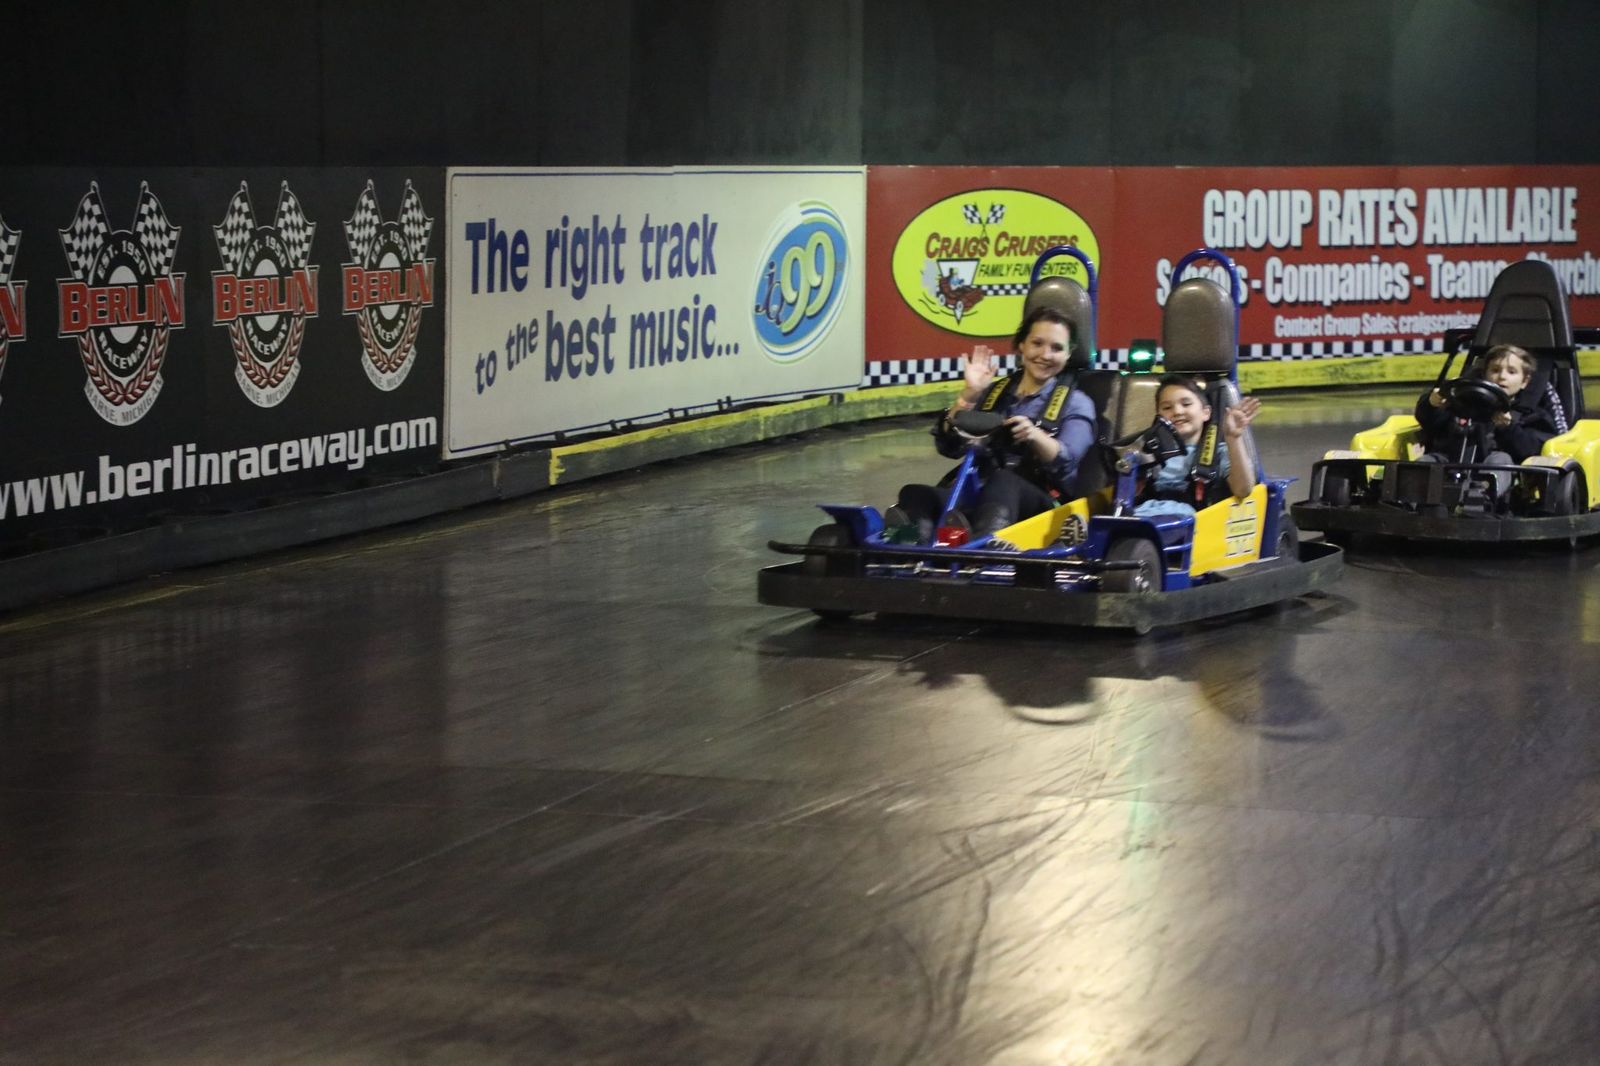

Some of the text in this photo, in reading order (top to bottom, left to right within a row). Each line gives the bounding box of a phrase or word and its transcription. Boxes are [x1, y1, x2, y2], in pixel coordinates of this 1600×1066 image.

[1203, 186, 1578, 250] GROUP RATES AVAILABLE
[121, 239, 149, 278] 1950
[465, 213, 719, 300] The right track
[1040, 262, 1080, 276] ENTERS
[1264, 255, 1410, 306] Companies
[1427, 253, 1508, 300] Team
[56, 273, 187, 338] BERLIN
[211, 265, 320, 326] BERLIN
[341, 258, 437, 316] BERLIN
[98, 328, 149, 370] RACEWAY
[246, 316, 288, 356] RACEWAY
[475, 350, 496, 395] to
[505, 318, 538, 371] the
[544, 304, 616, 382] best
[629, 294, 740, 370] music...
[1275, 314, 1323, 337] Contact
[1324, 313, 1361, 337] Group
[0, 415, 438, 520] ww.berlinraceway.com
